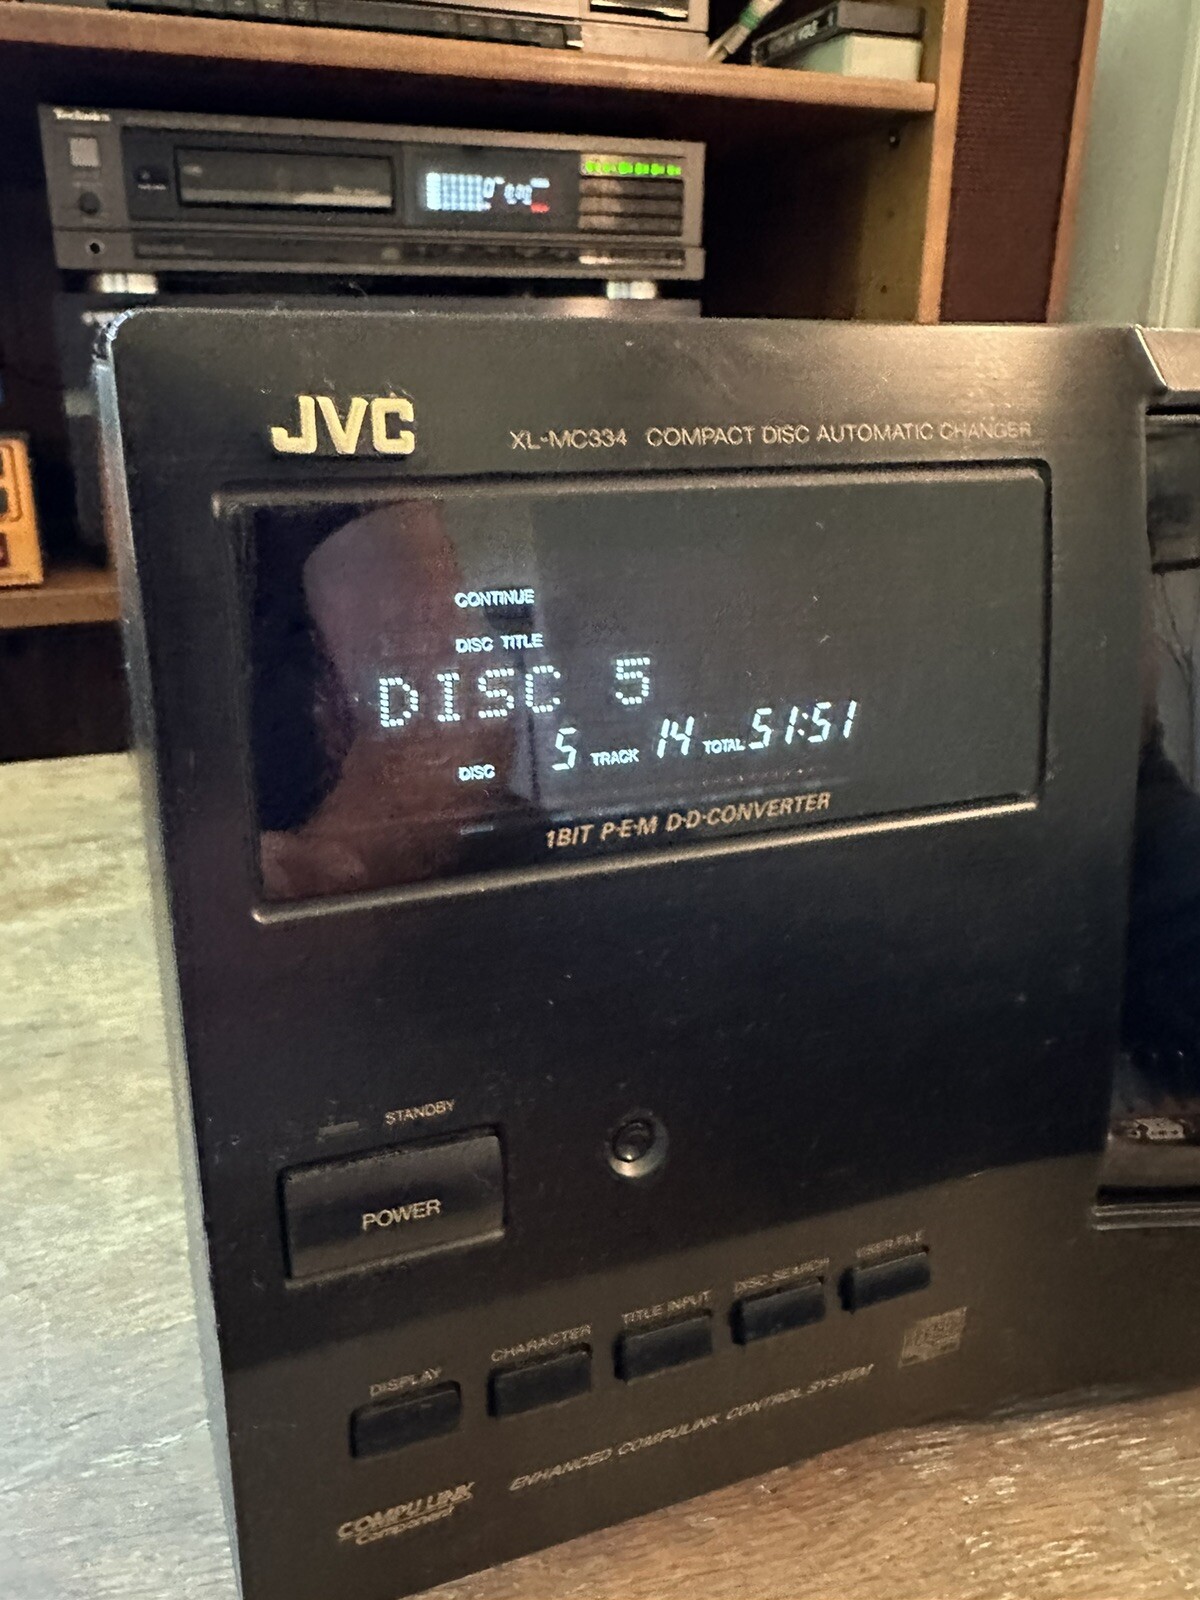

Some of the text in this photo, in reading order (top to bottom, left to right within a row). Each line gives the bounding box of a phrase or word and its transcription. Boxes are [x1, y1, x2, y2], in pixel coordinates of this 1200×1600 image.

[271, 395, 415, 455] JVC
[509, 420, 1032, 450] XL-MC334 COMPACT DISC AUTOMATIC CHANGER
[454, 588, 535, 608] CONTINUE
[455, 633, 543, 653] DISC TITLE
[379, 656, 651, 727] DISC 5
[458, 700, 857, 782] DISC 5 TRACK 14 TOTAL 51:51
[545, 823, 594, 850] 1BIT
[385, 1099, 456, 1125] STANDBY
[362, 1198, 442, 1232] POWER
[621, 1302, 664, 1325] TITLE
[490, 1323, 593, 1363] CHARACTER
[369, 1366, 443, 1398] DISPLAY
[509, 1448, 613, 1491] ENHANCED
